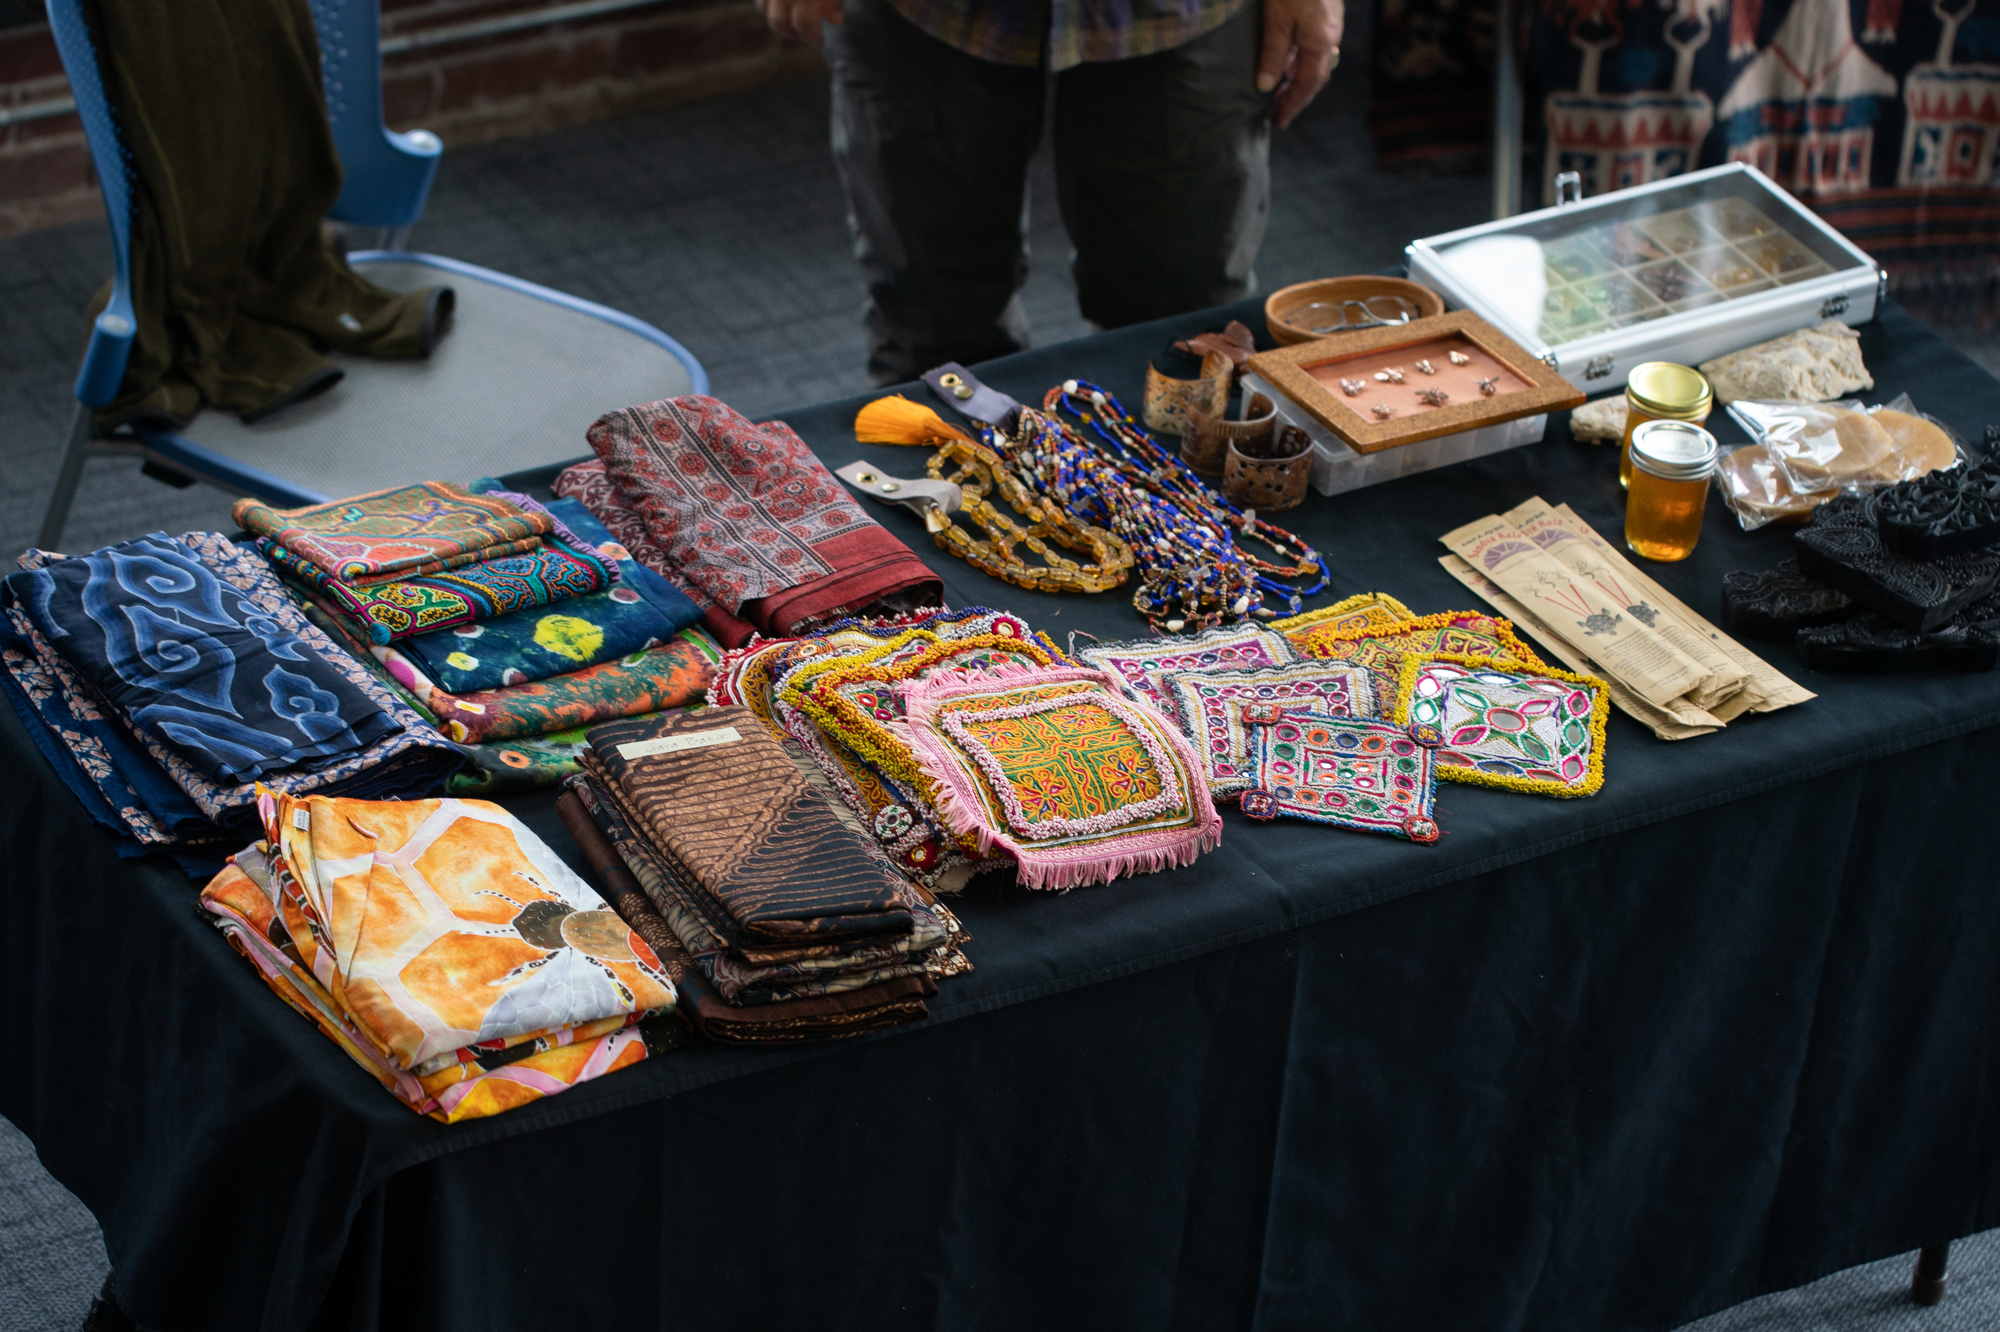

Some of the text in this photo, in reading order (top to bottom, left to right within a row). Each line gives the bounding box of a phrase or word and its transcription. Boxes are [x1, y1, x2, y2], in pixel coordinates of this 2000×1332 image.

[1538, 518, 1563, 528] Kala
[1467, 536, 1497, 560] Sandya
[1498, 530, 1522, 540] Kala
[646, 742, 679, 753] Java
